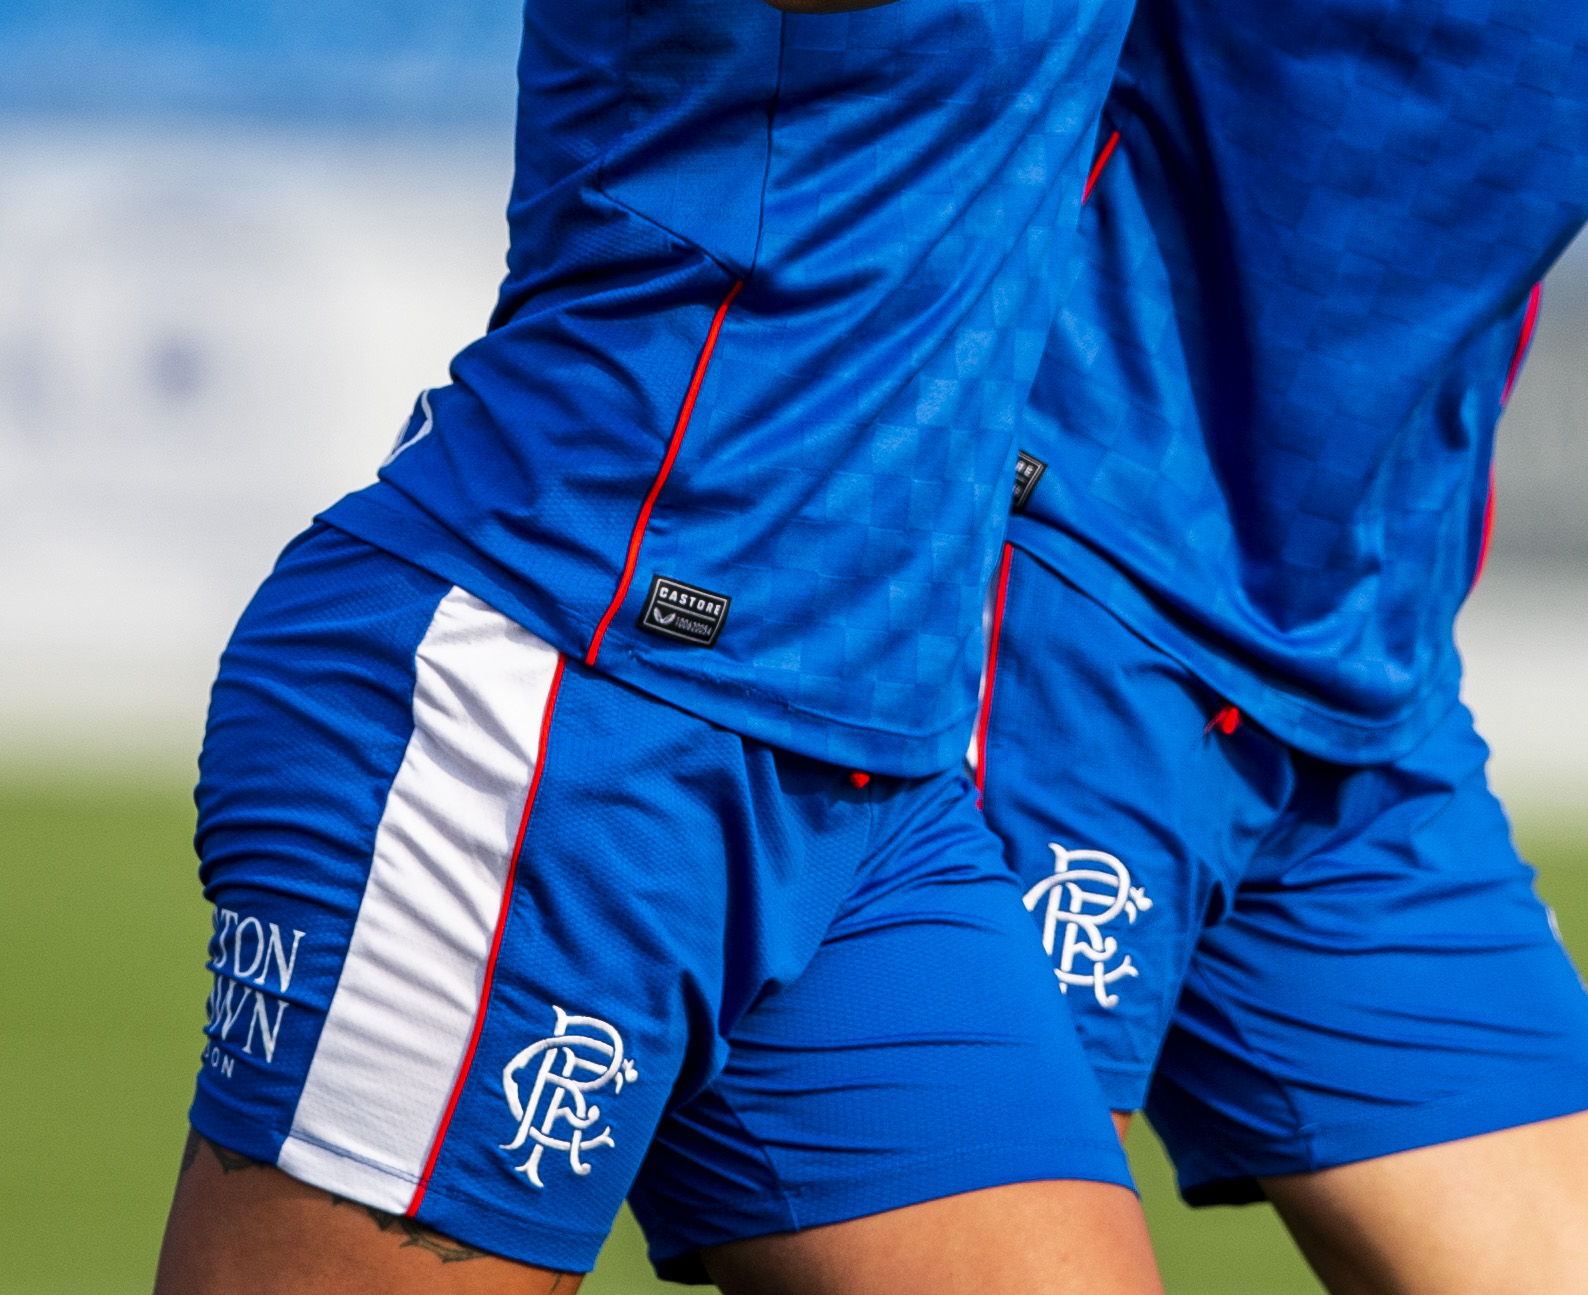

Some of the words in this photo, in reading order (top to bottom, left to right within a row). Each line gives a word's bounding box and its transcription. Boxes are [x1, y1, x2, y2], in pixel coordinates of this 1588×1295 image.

[658, 586, 722, 617] CASTORE
[212, 907, 306, 993] TON
[209, 975, 289, 1063] WN
[204, 1045, 235, 1079] ON
